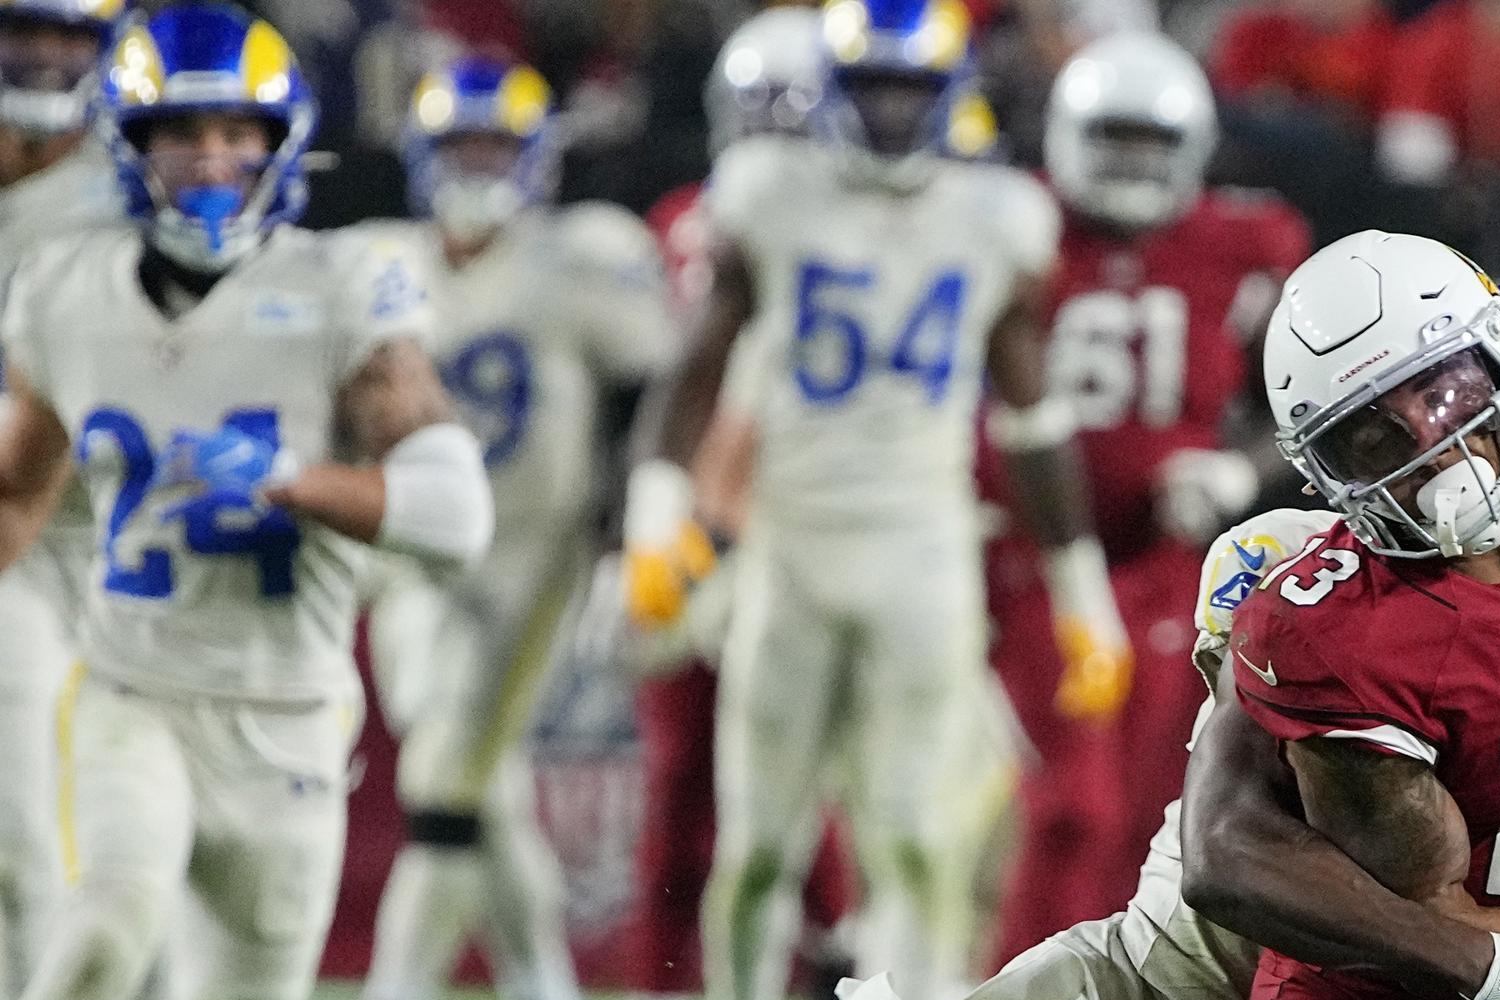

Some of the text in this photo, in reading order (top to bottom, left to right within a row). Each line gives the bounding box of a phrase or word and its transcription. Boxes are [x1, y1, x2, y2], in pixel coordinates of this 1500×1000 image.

[796, 261, 967, 405] 54
[1049, 287, 1187, 430] 61
[1338, 349, 1390, 383] CARDINALS
[80, 408, 298, 598] 24
[1258, 537, 1361, 606] 13
